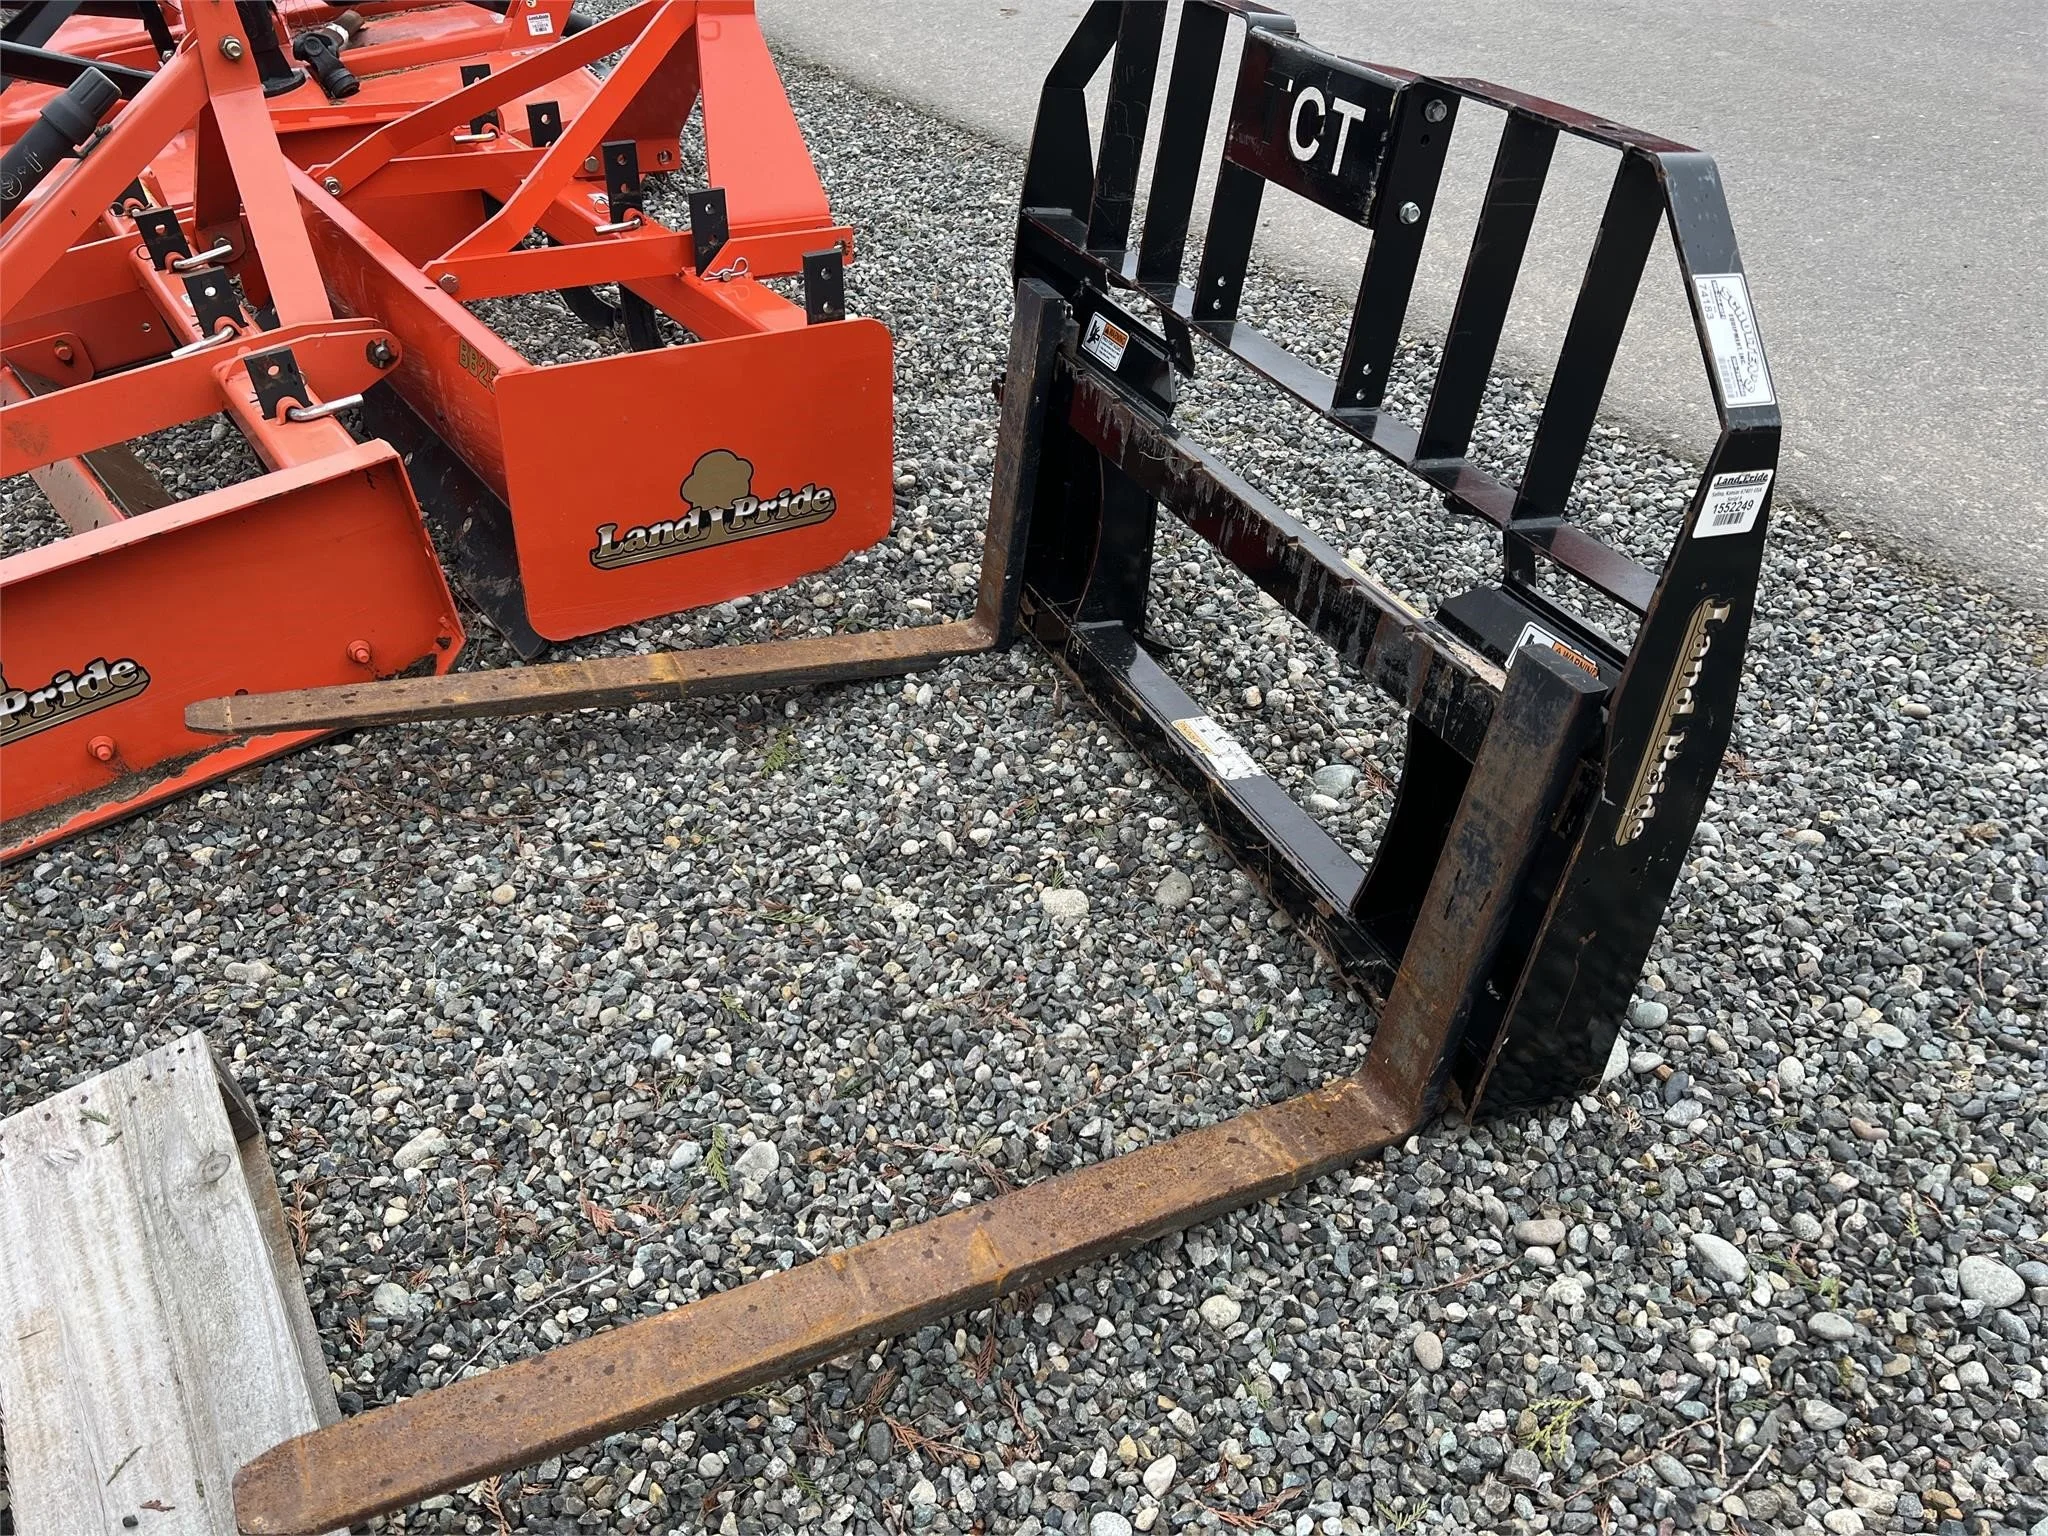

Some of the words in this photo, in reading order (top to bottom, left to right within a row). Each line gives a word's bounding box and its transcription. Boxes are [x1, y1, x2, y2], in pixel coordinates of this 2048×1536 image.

[1699, 283, 1714, 320] 74183
[1713, 500, 1754, 514] 1552249
[1714, 475, 1743, 487] Land
[595, 507, 703, 559] Land
[729, 483, 832, 530] Pride
[1669, 602, 1732, 716] Land
[1625, 731, 1686, 840] Pride
